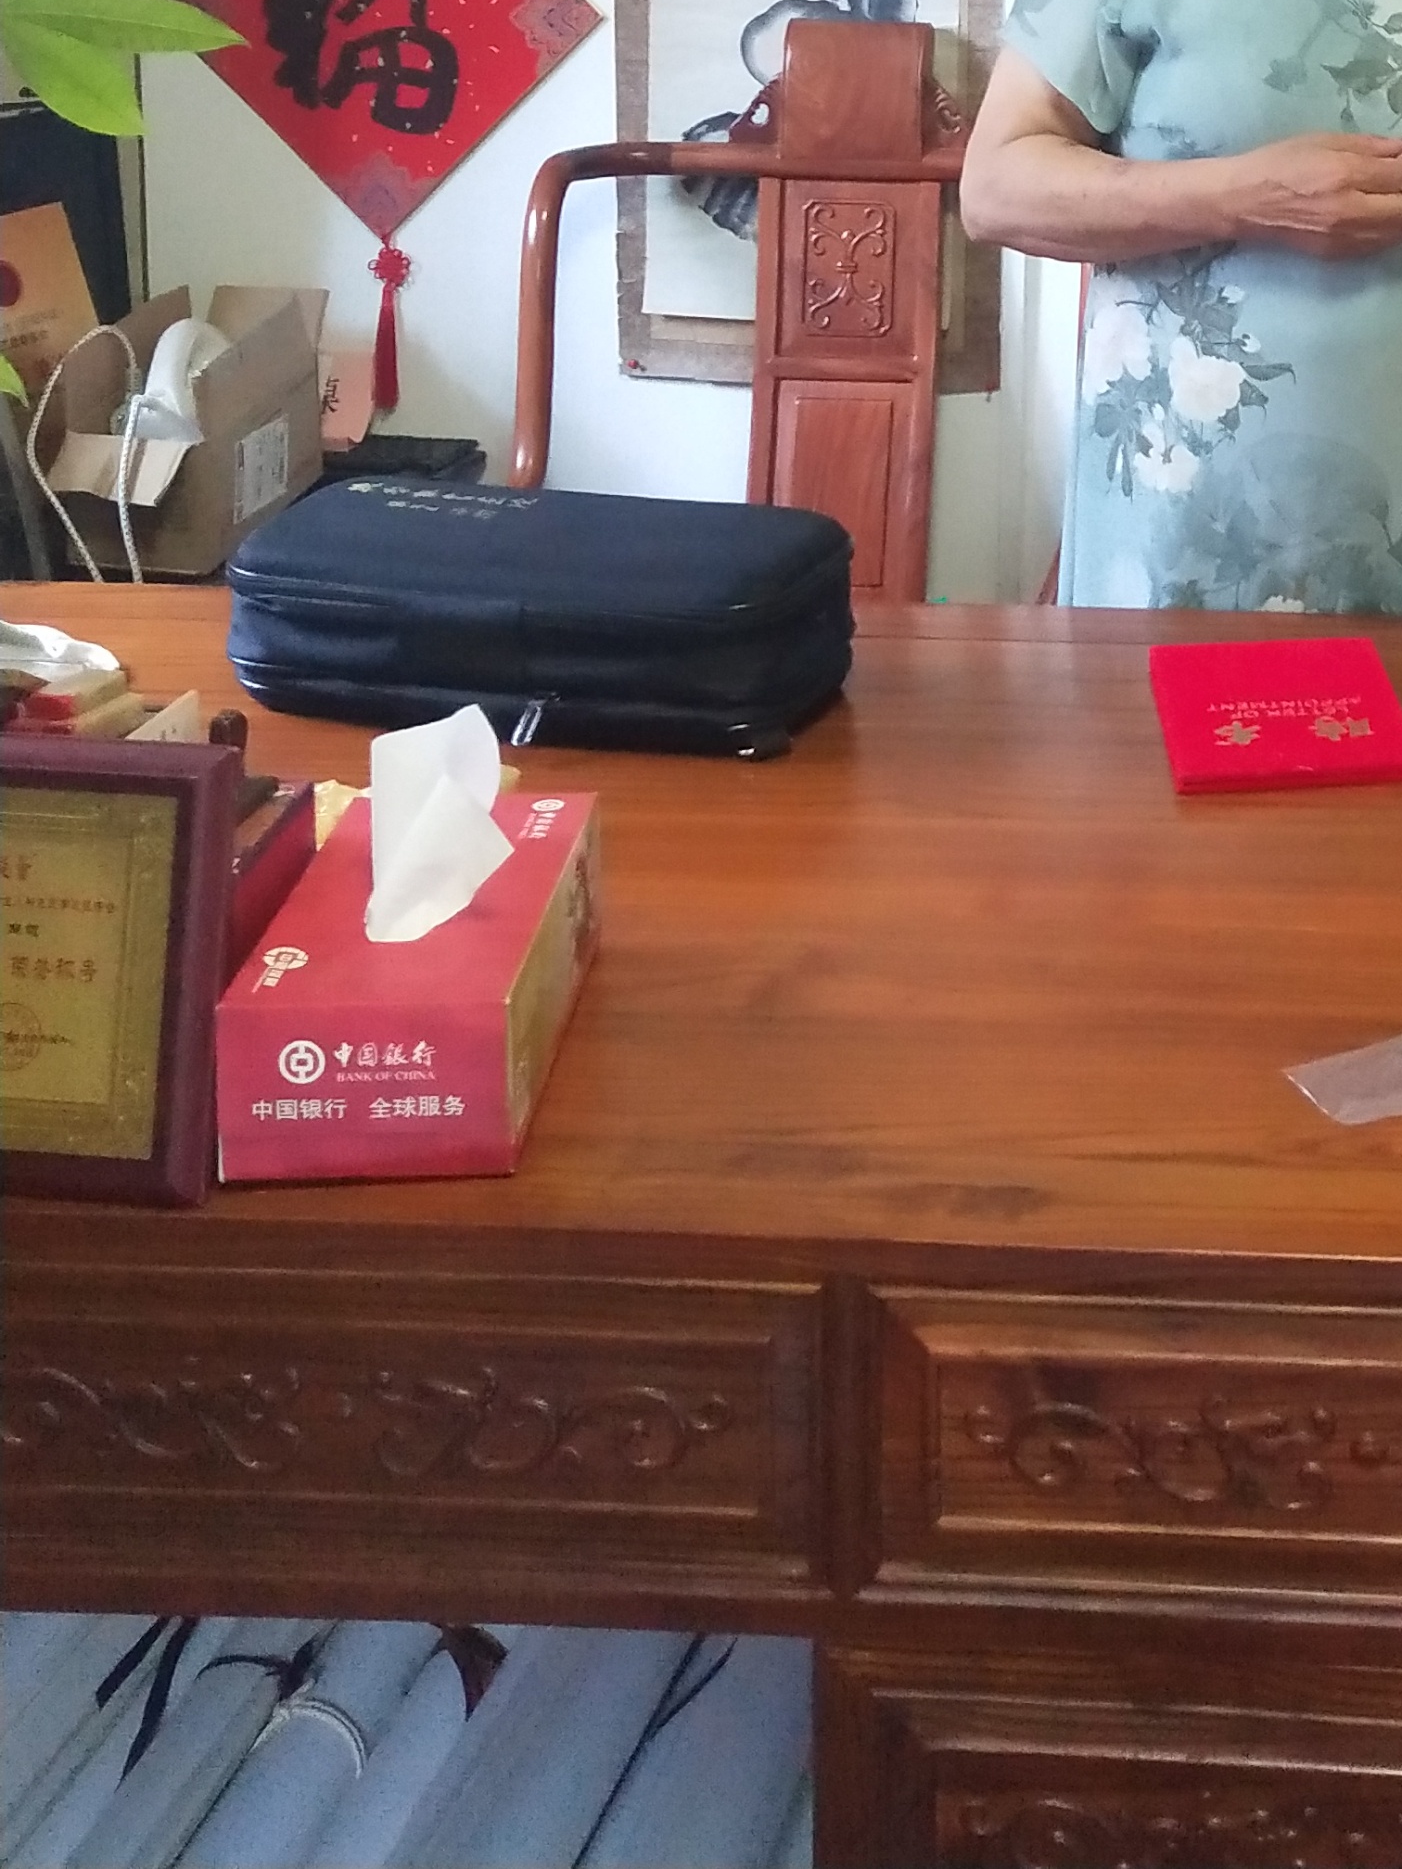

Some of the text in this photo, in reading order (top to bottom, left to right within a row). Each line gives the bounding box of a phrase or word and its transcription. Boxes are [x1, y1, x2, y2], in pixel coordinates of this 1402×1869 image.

[336, 1070, 437, 1083] BANK OF CHINA
[251, 1094, 466, 1121] 中国银行 全球服务
